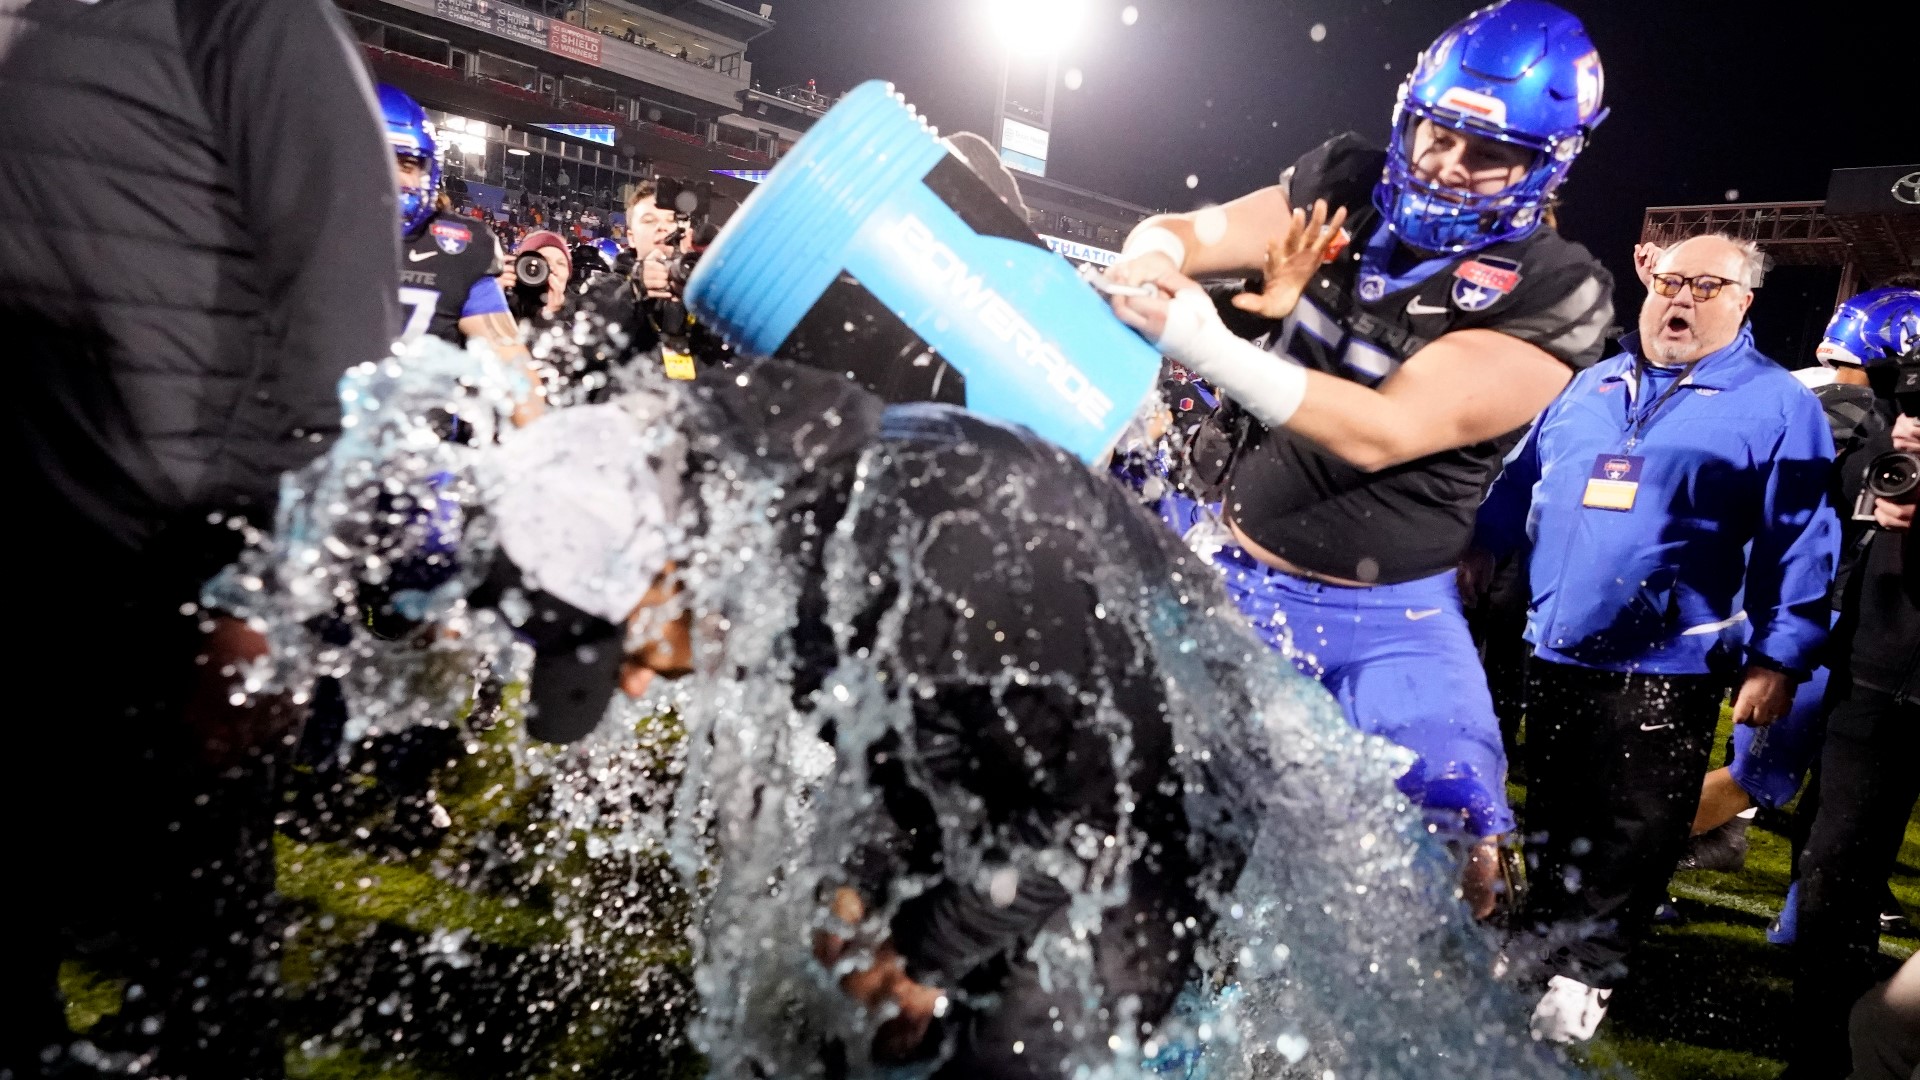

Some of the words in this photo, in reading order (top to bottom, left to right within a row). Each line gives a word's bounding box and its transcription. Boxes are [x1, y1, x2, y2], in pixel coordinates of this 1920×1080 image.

[448, 11, 491, 28] CHAMPIONS
[462, 9, 478, 18] OPEN
[507, 10, 530, 22] LAMAR
[507, 17, 530, 28] HUNT
[519, 27, 535, 35] OPEN
[506, 29, 547, 46] CHAMPIONS
[551, 25, 560, 49] 2016
[561, 34, 598, 53] SHIELD
[560, 44, 598, 61] WINNERS
[886, 213, 1114, 430] POWERADE
